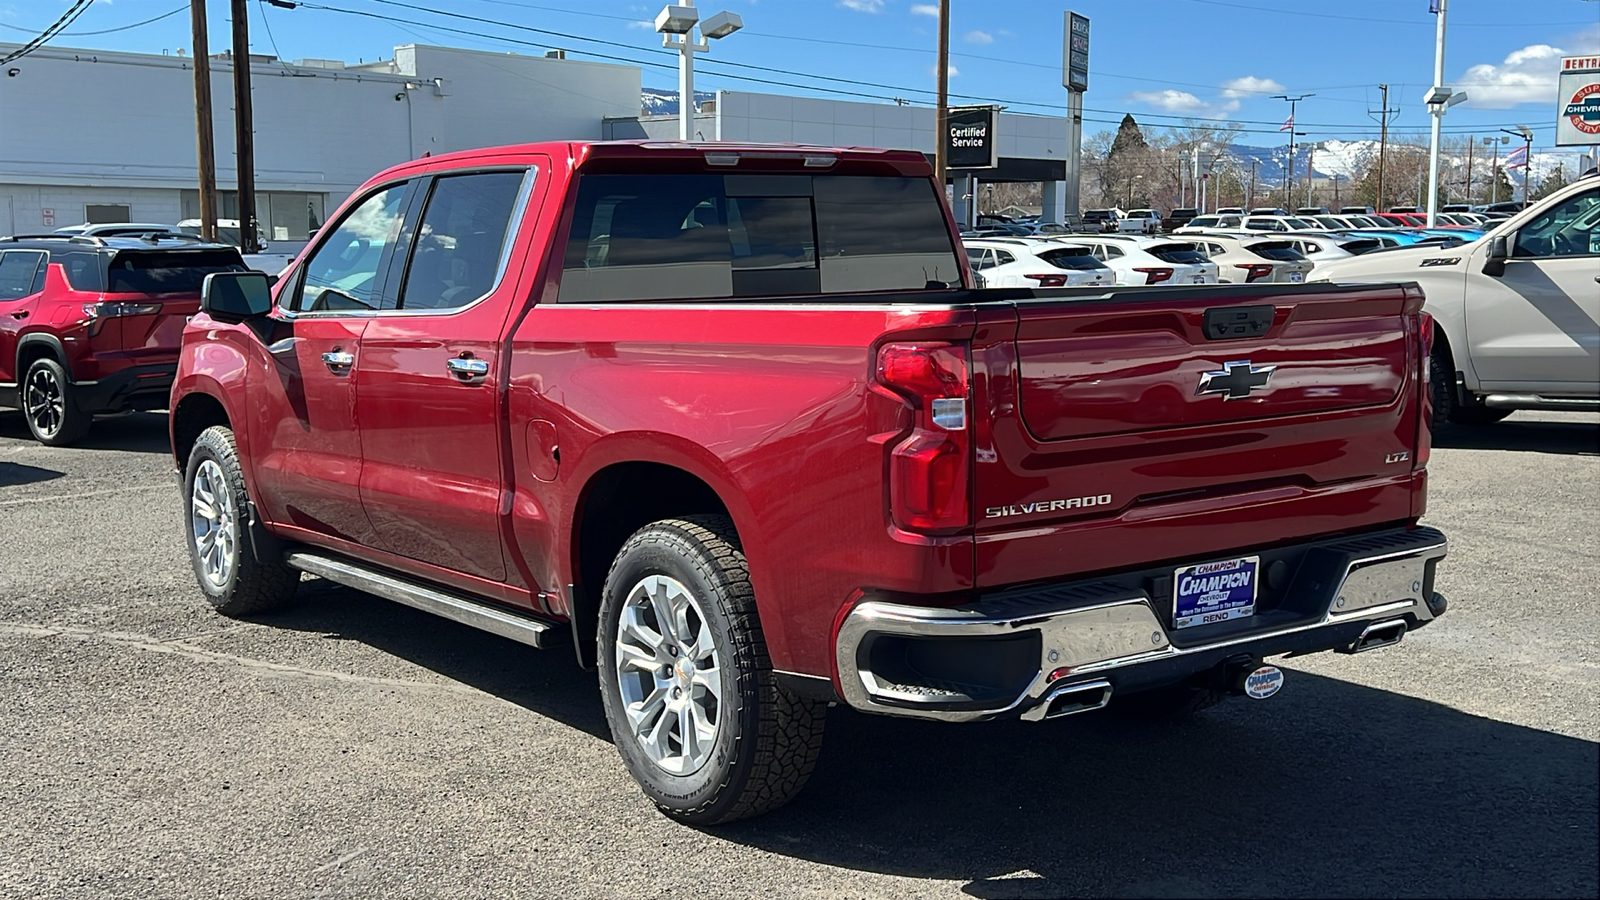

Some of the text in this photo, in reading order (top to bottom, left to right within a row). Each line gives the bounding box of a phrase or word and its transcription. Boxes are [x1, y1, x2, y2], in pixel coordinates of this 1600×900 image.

[1577, 84, 1600, 98] SUP
[950, 127, 986, 137] Certified
[952, 137, 983, 147] Service
[1385, 451, 1409, 464] LTZ
[985, 494, 1112, 518] SILVERADO
[1198, 561, 1238, 574] CHAMPION
[1180, 571, 1251, 597] CHAMPION
[1199, 592, 1228, 603] CHEVROLET
[1202, 612, 1229, 623] RENO
